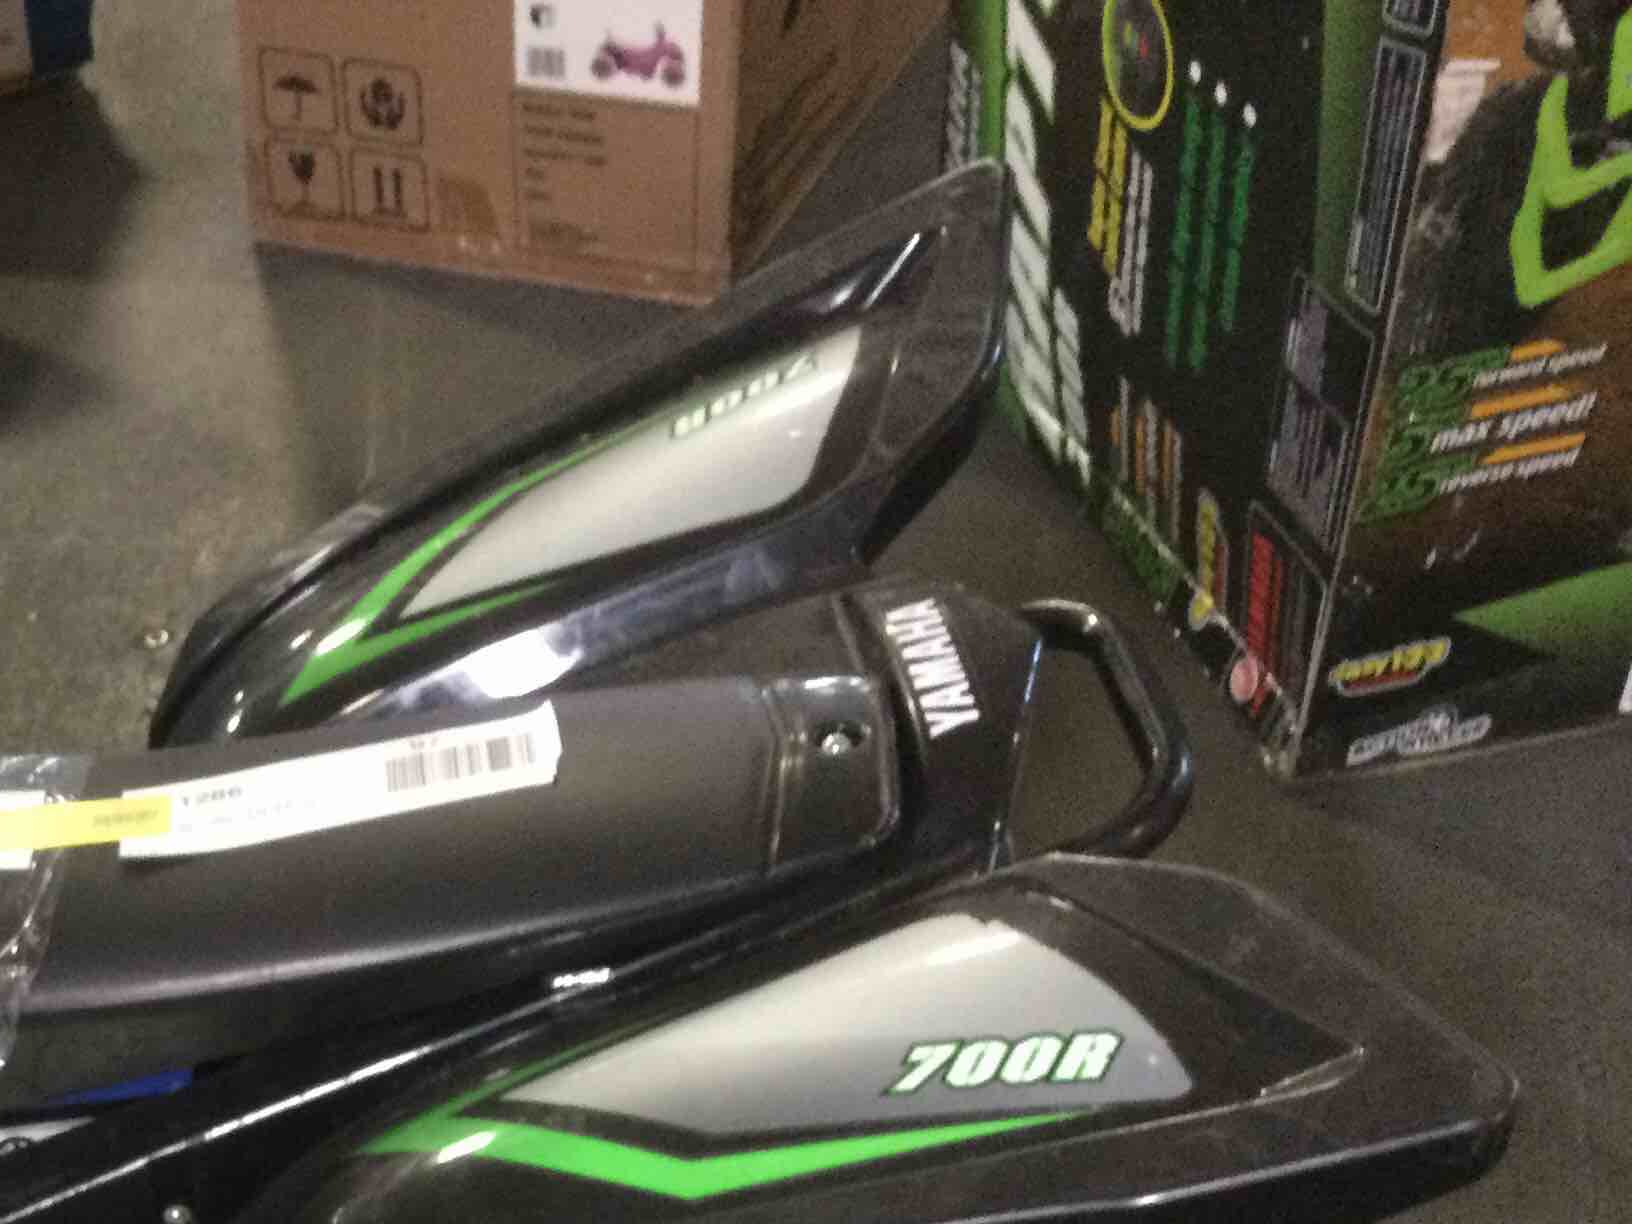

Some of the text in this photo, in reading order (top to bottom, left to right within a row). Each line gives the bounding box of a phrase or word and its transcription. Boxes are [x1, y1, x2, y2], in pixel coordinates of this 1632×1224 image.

[1498, 391, 1598, 440] speed
[884, 598, 981, 739] YAMAHA
[884, 1030, 1123, 1096] 700R
